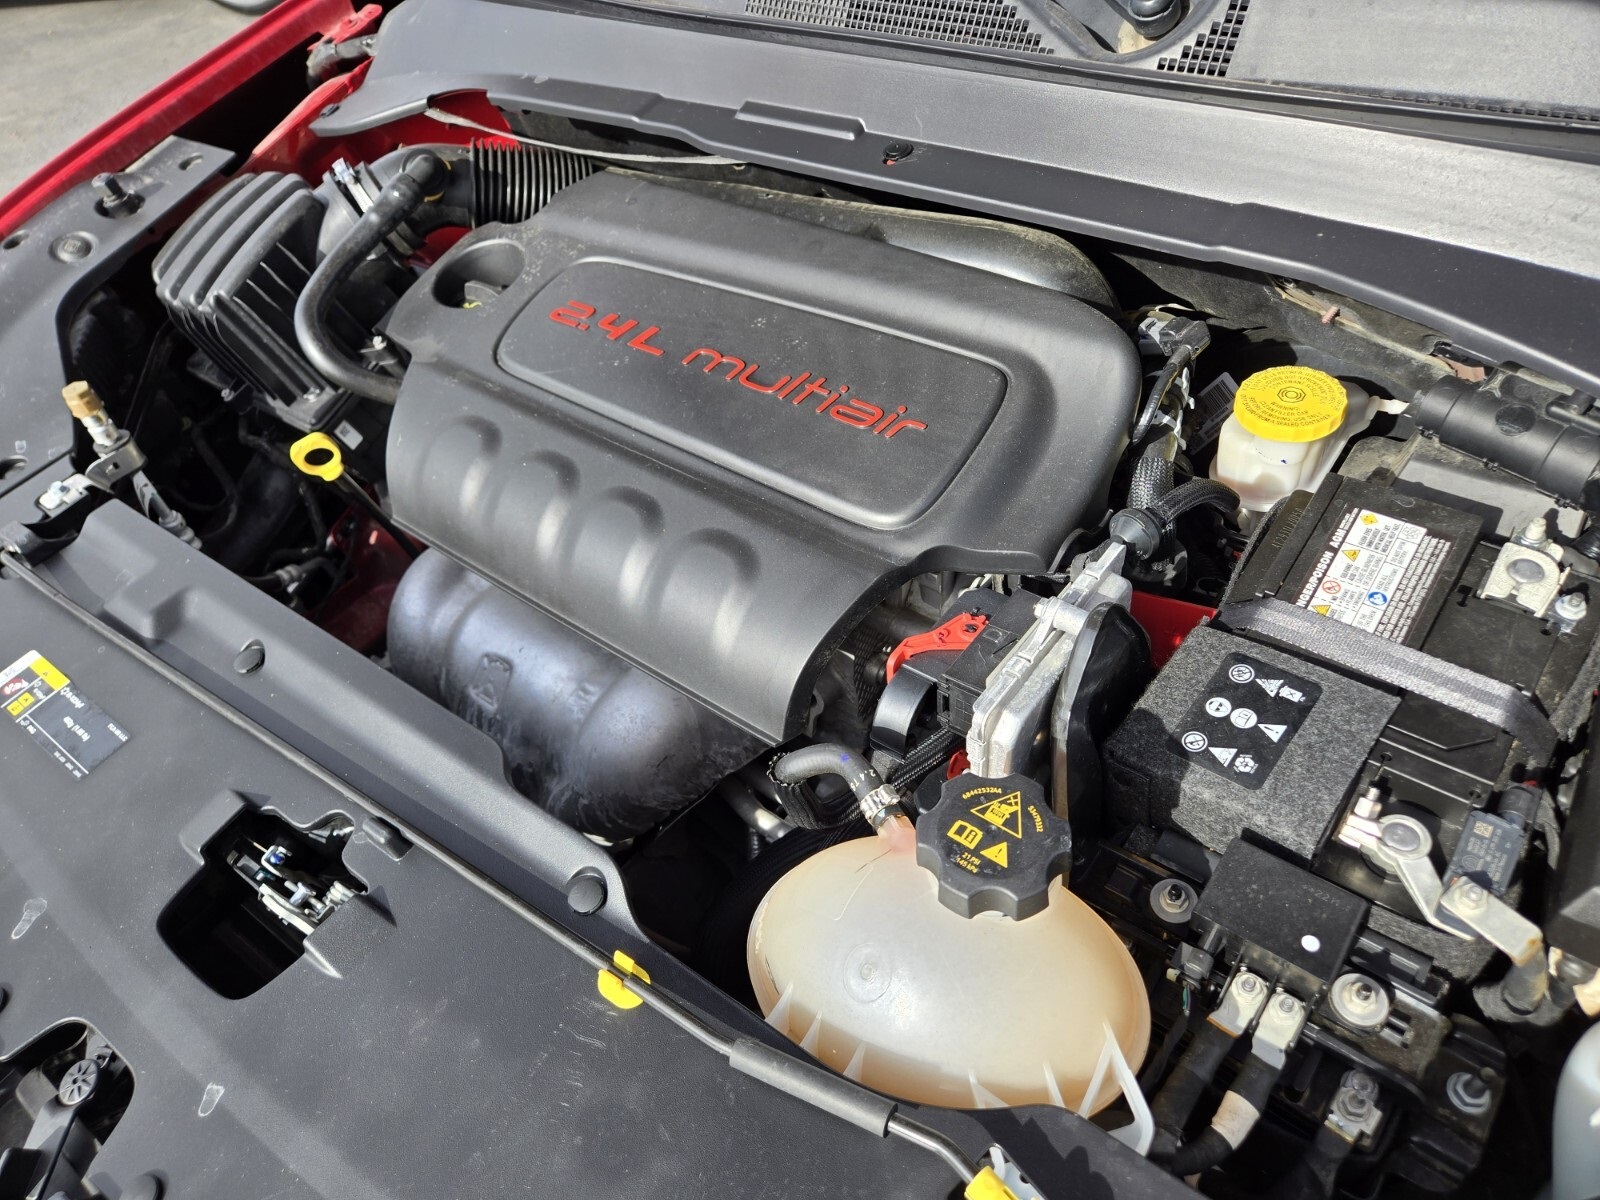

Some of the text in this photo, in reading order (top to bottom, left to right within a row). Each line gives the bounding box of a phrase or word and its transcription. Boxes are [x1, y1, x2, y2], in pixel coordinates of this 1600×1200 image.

[549, 300, 928, 439] 2.4L multiair
[1328, 527, 1346, 548] AGM
[970, 856, 980, 864] PSI
